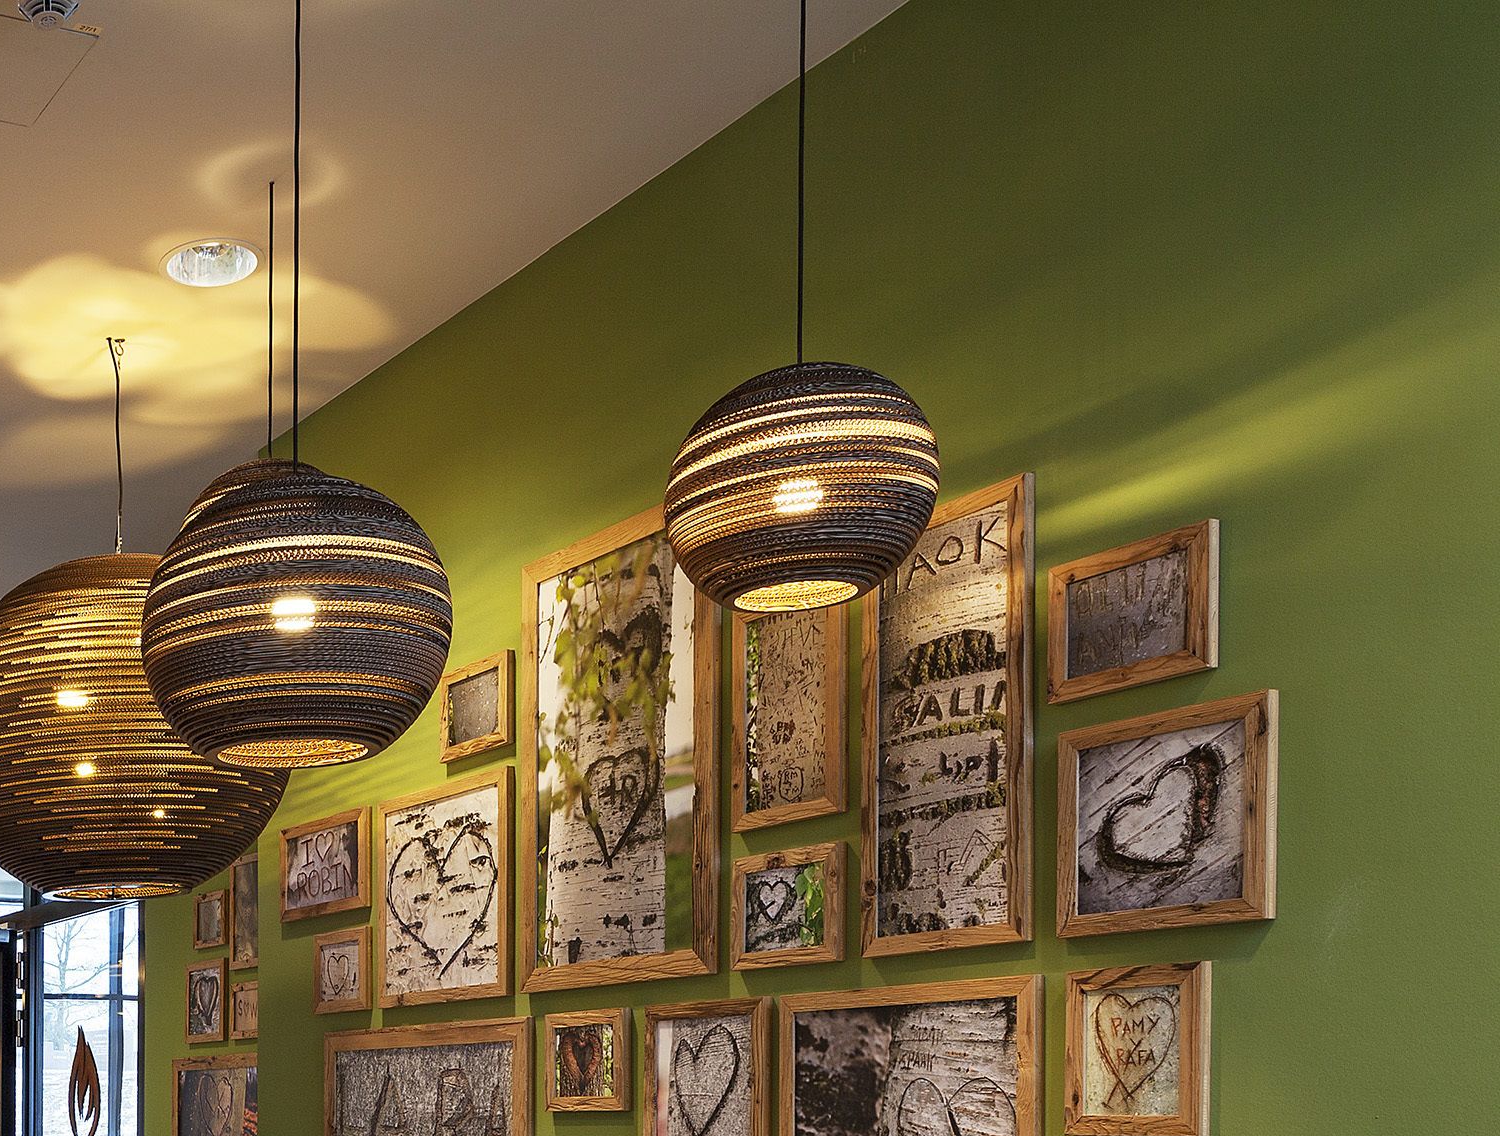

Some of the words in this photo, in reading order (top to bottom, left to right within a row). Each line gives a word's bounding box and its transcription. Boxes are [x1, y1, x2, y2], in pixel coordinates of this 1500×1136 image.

[300, 837, 315, 869] I
[296, 861, 356, 901] ROBIN
[1110, 1015, 1161, 1038] PAMY
[1116, 1048, 1156, 1071] RAFA
